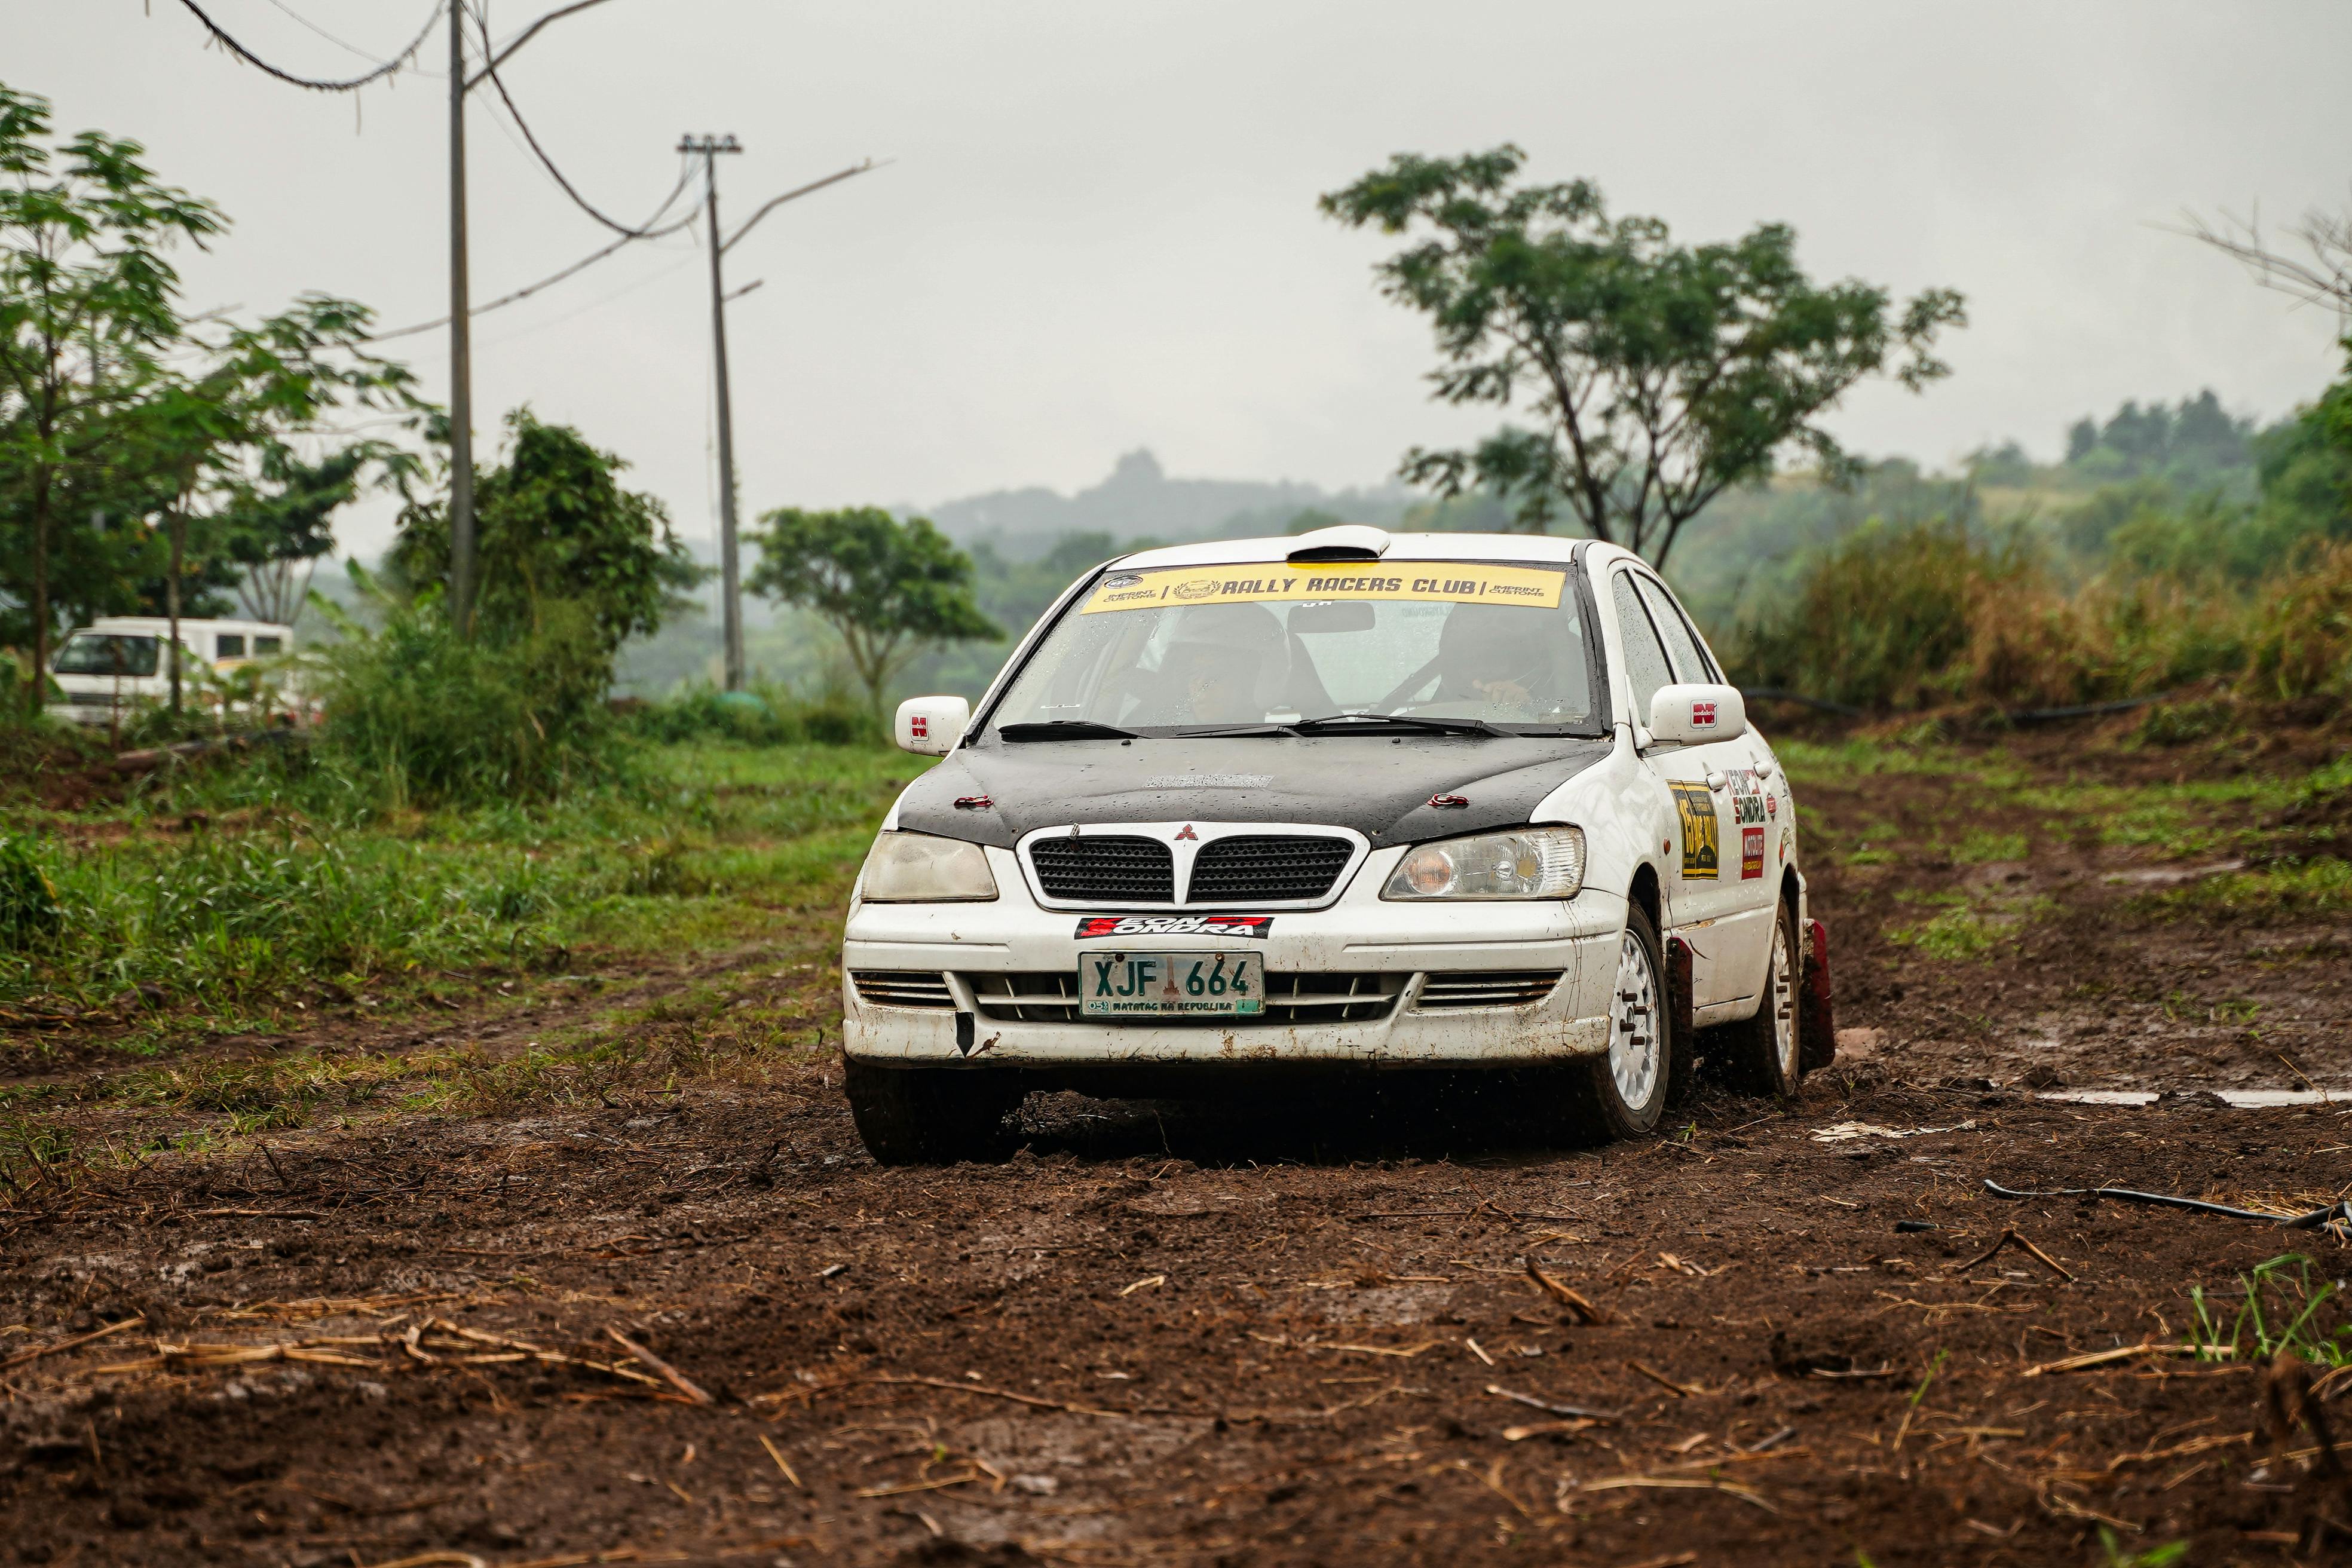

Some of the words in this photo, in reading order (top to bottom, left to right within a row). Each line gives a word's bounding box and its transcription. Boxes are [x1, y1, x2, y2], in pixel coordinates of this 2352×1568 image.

[1221, 578, 1298, 595] RALLY
[1306, 577, 1402, 592] RACERS
[1411, 578, 1477, 595] CLUB
[1493, 584, 1543, 593] IMPRINT
[1103, 593, 1157, 602] CUSTOMS
[1108, 589, 1156, 598] IMPRINT
[1733, 797, 1766, 825] SONDRA
[1086, 917, 1209, 927] KEON
[1080, 924, 1254, 936] SONDRA
[1094, 960, 1157, 997] XJF
[1186, 960, 1249, 996] 664
[1113, 1002, 1158, 1011] MATATAG
[1160, 1002, 1174, 1011] NA
